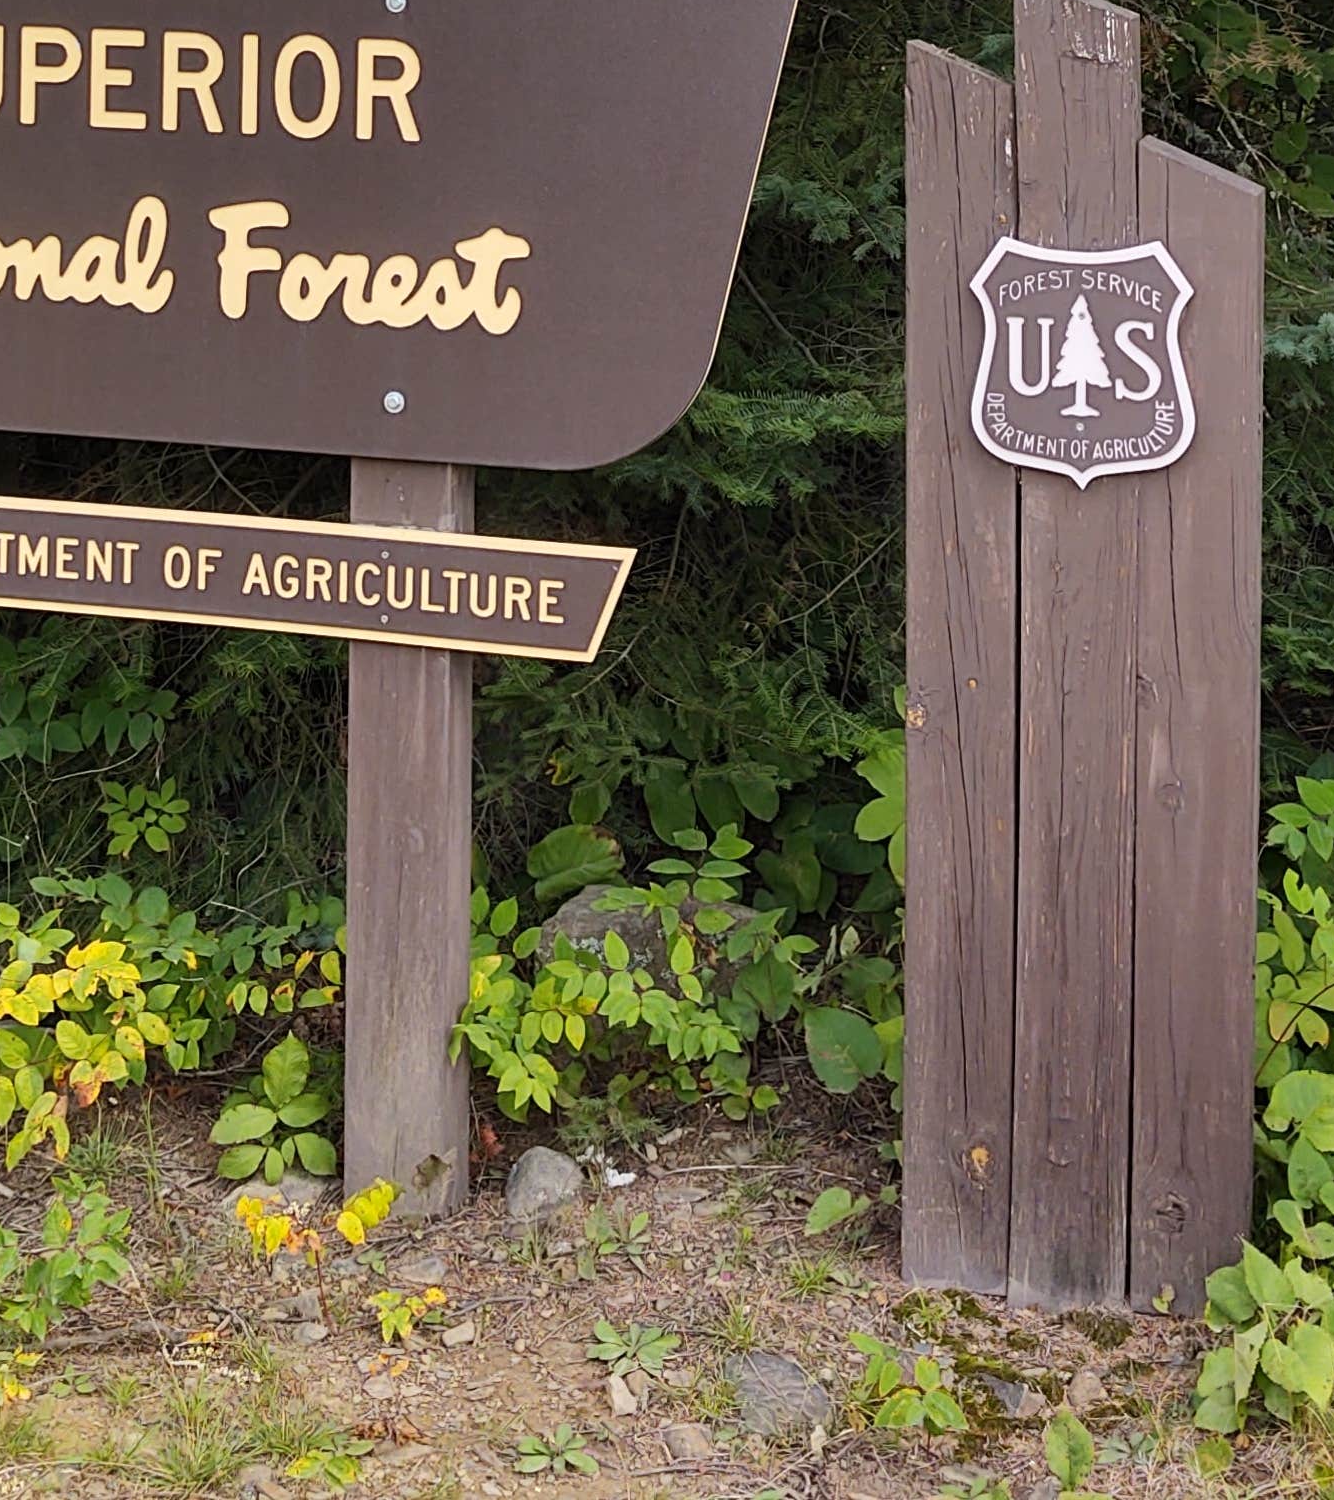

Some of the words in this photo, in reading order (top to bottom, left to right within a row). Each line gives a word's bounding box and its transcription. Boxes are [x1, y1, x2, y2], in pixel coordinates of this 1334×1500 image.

[208, 201, 531, 335] Forest
[999, 270, 1074, 306] FOREST
[1081, 270, 1163, 313] SERVICE
[987, 392, 1067, 458] DEPARTMENT
[1071, 440, 1090, 459] OF
[1093, 400, 1174, 459] AGRICULTURE
[163, 549, 223, 592] OF
[243, 553, 566, 624] AGRICULTURE
